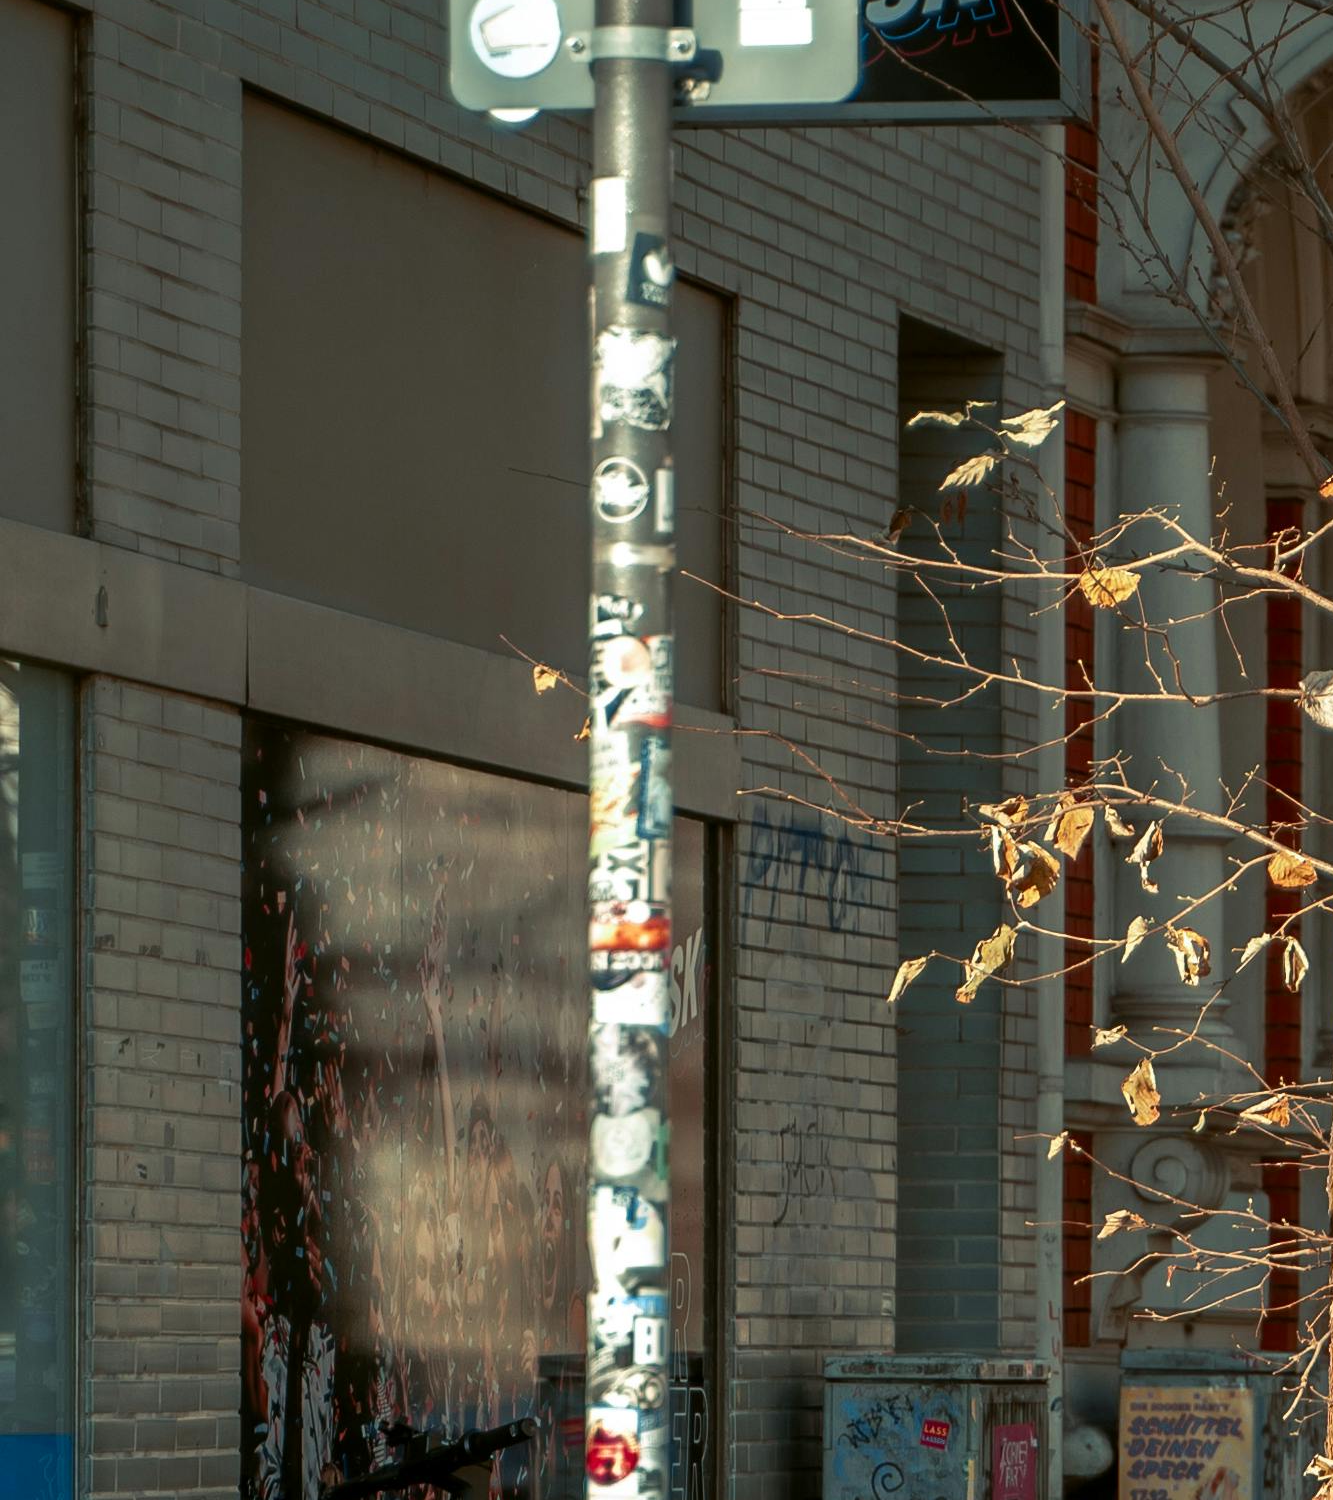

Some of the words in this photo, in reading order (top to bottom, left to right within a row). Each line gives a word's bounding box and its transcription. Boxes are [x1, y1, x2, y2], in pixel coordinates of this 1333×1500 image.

[924, 1423, 947, 1437] LASS
[1127, 1413, 1244, 1440] SCHÜTTEL
[1126, 1438, 1220, 1458] DEINEN
[1127, 1459, 1205, 1480] SPECK
